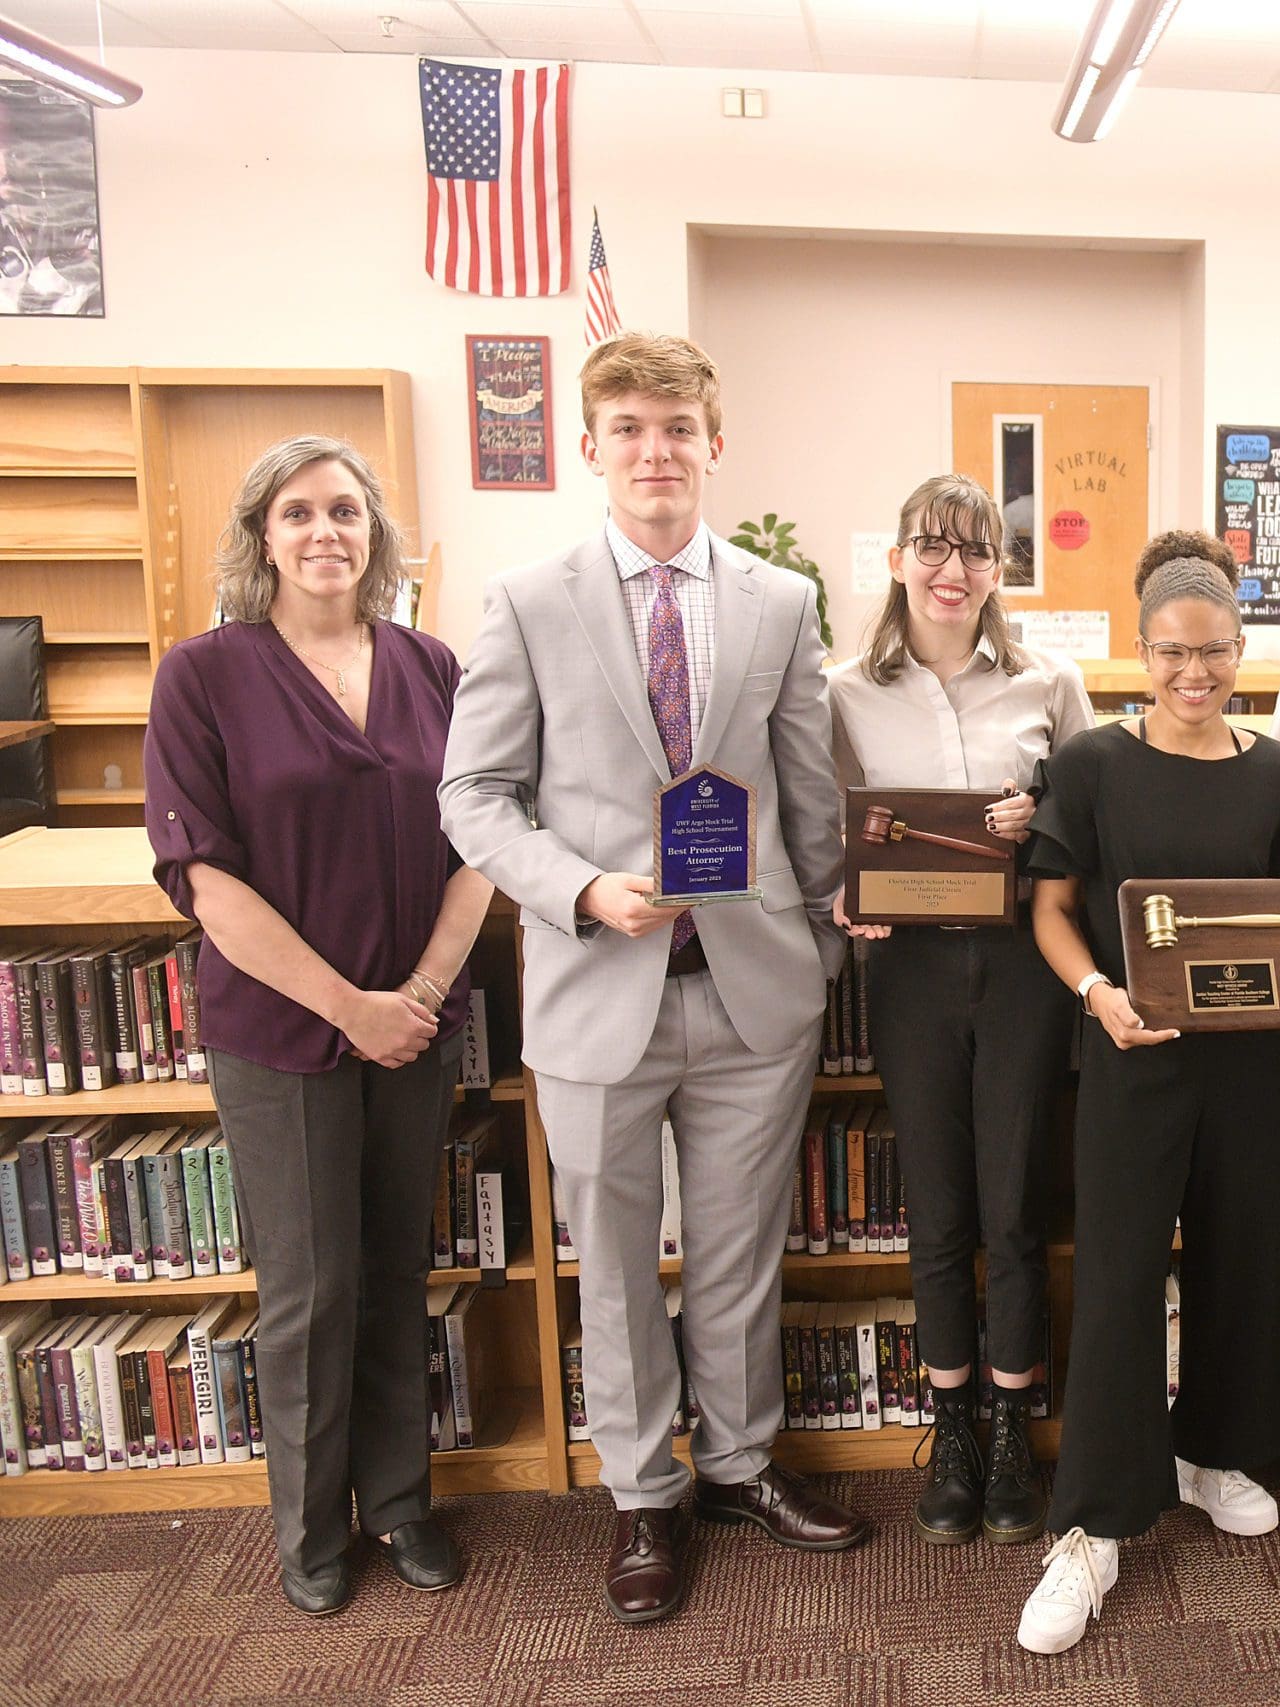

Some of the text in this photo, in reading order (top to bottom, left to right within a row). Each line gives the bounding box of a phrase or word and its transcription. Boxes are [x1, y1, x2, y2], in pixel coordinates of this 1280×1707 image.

[479, 349, 490, 363] I
[484, 397, 535, 412] AMERICA
[1055, 451, 1127, 477] VIRTUAL
[1073, 477, 1108, 493] LAB
[1055, 518, 1086, 528] STOP
[1238, 564, 1274, 579] Change
[705, 818, 720, 826] Mock
[671, 828, 685, 836] High
[667, 844, 743, 856] Best Prosecution
[685, 857, 725, 865] Attorney
[910, 878, 925, 886] High
[20, 998, 33, 1040] FLAME
[187, 1005, 197, 1034] BLOOD
[4, 1043, 12, 1058] THE
[850, 1134, 859, 1144] 3
[187, 1157, 197, 1169] 2
[216, 1155, 224, 1166] 2
[53, 1148, 67, 1195] BROKEN
[77, 1179, 91, 1200] the
[161, 1179, 182, 1217] Shadow
[189, 1173, 204, 1237] SIEGE STORM
[215, 1171, 232, 1235] SIEGE STORM
[78, 1200, 98, 1230] Wild
[479, 1176, 495, 1264] Fantasy
[862, 1328, 870, 1342] 9
[819, 1343, 827, 1372] BUTCHER
[839, 1341, 847, 1370] BUTCHER
[878, 1338, 887, 1366] BUTCHER
[899, 1339, 907, 1370] BUTCHER
[191, 1335, 214, 1418] WEREGIRL
[141, 1406, 150, 1417] FLIP
